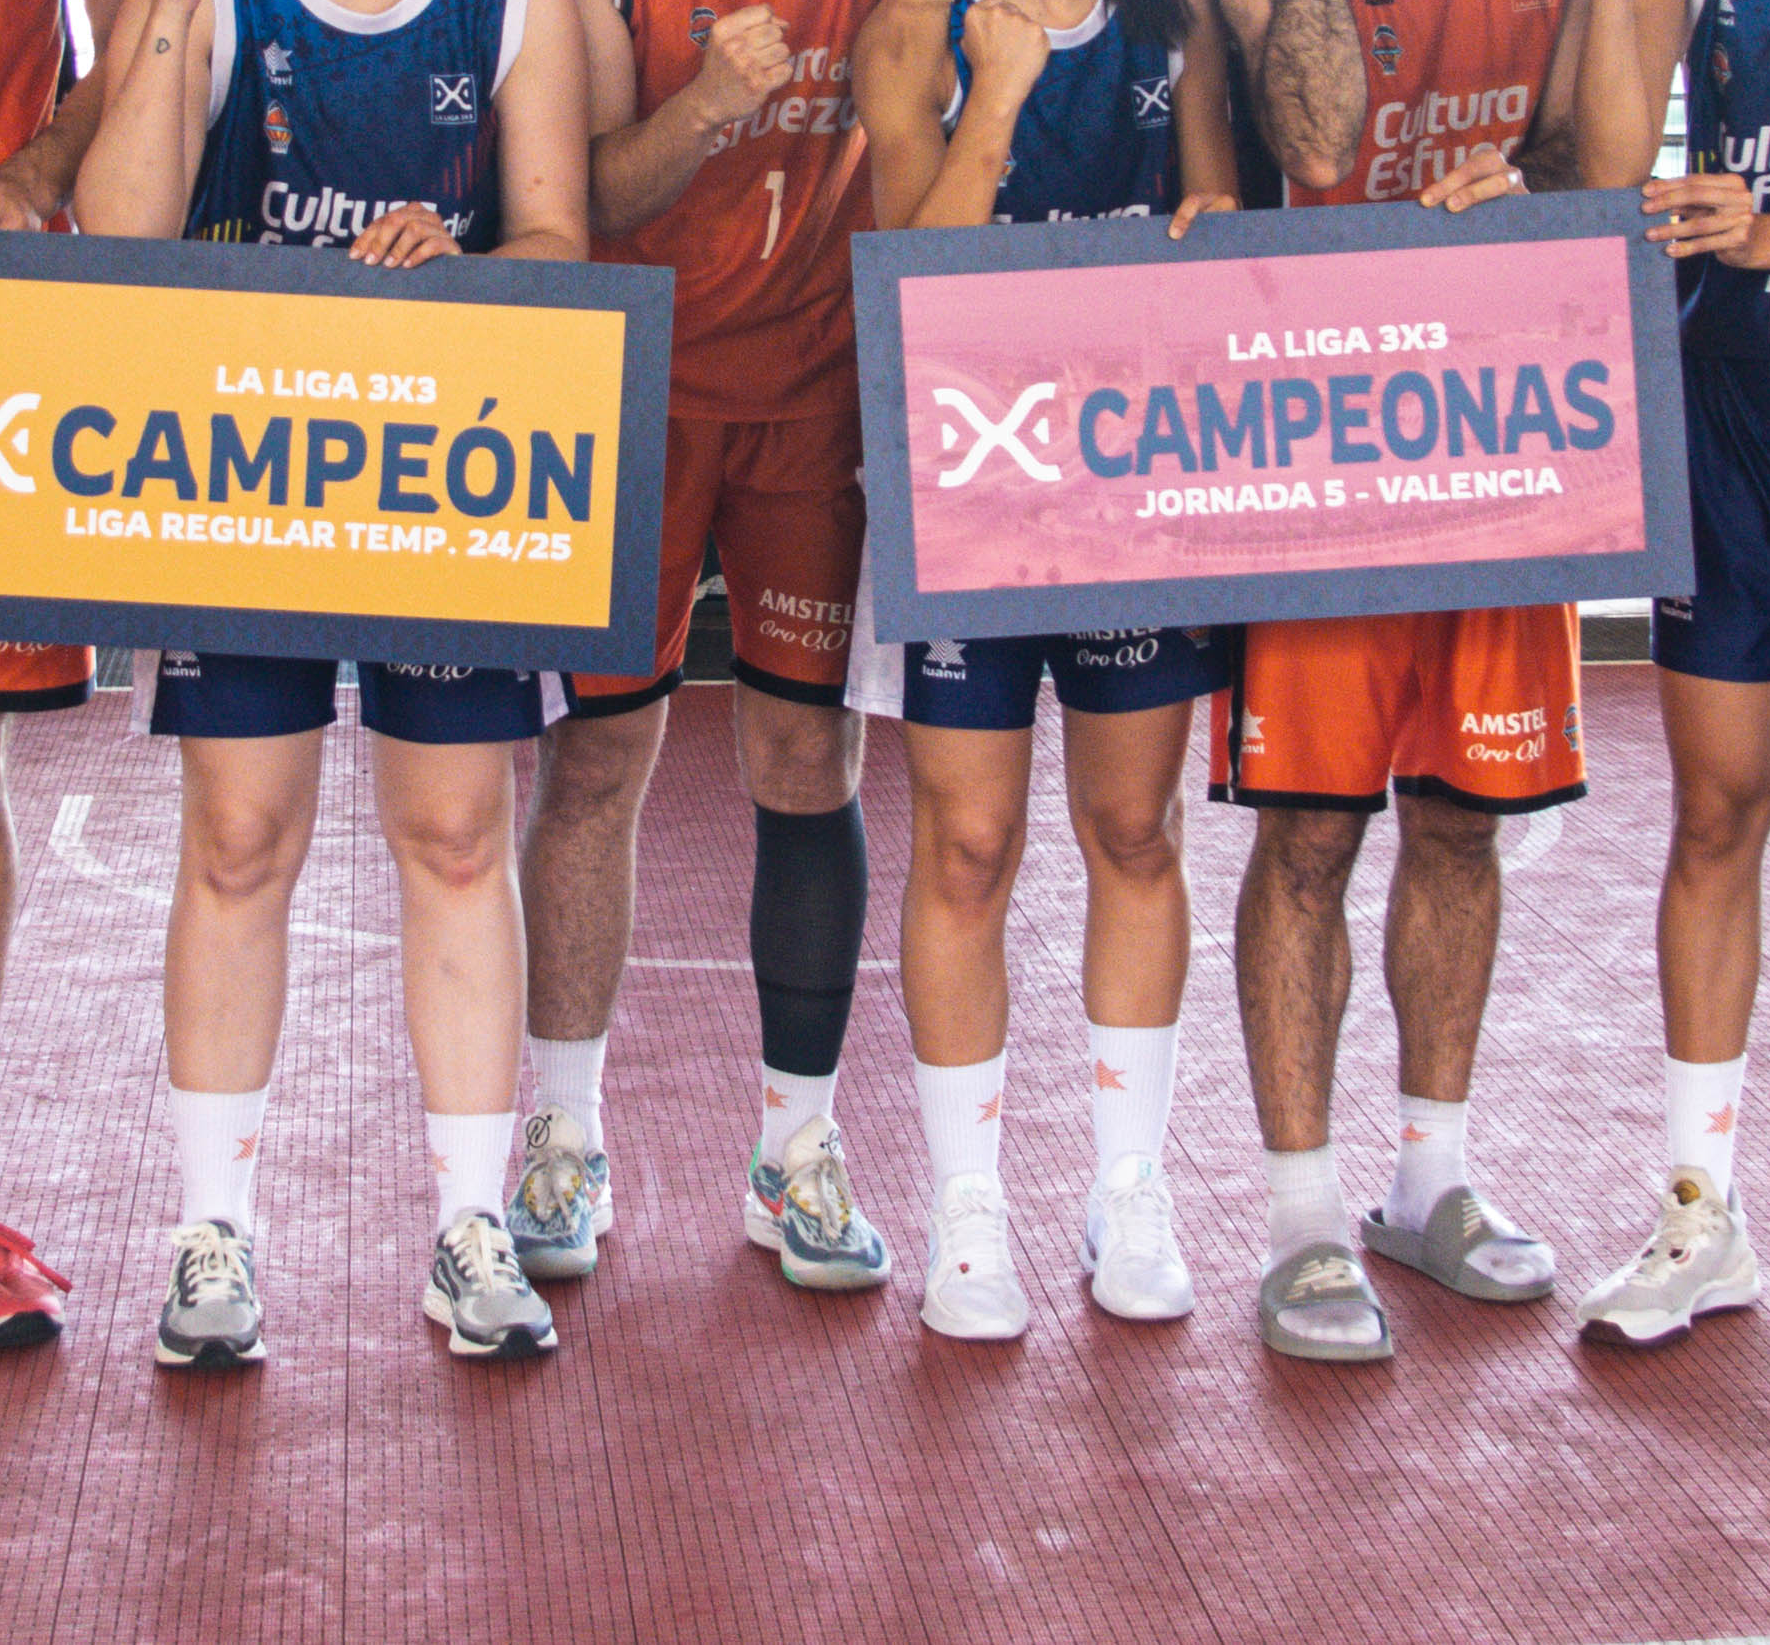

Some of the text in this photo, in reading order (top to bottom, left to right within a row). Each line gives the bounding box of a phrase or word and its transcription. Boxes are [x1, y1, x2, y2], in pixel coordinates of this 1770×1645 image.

[1374, 85, 1529, 149] Cultura
[760, 170, 786, 260] 1
[1227, 321, 1449, 361] LA LIGA 3X3
[215, 365, 438, 404] LA LIGA 3X3
[1078, 359, 1616, 480] CAMPEONAS
[50, 396, 596, 523] CAMPEÓN
[1134, 481, 1317, 519] JORNADA
[1323, 478, 1347, 507] 5
[1376, 466, 1564, 504] VALENCIA
[65, 507, 573, 562] LIGA REGULAR TEMP. 24/25
[758, 588, 855, 625] AMSTEL
[162, 665, 201, 679] luanvi
[922, 665, 967, 680] luanvi
[1460, 706, 1548, 736] AMSTEL
